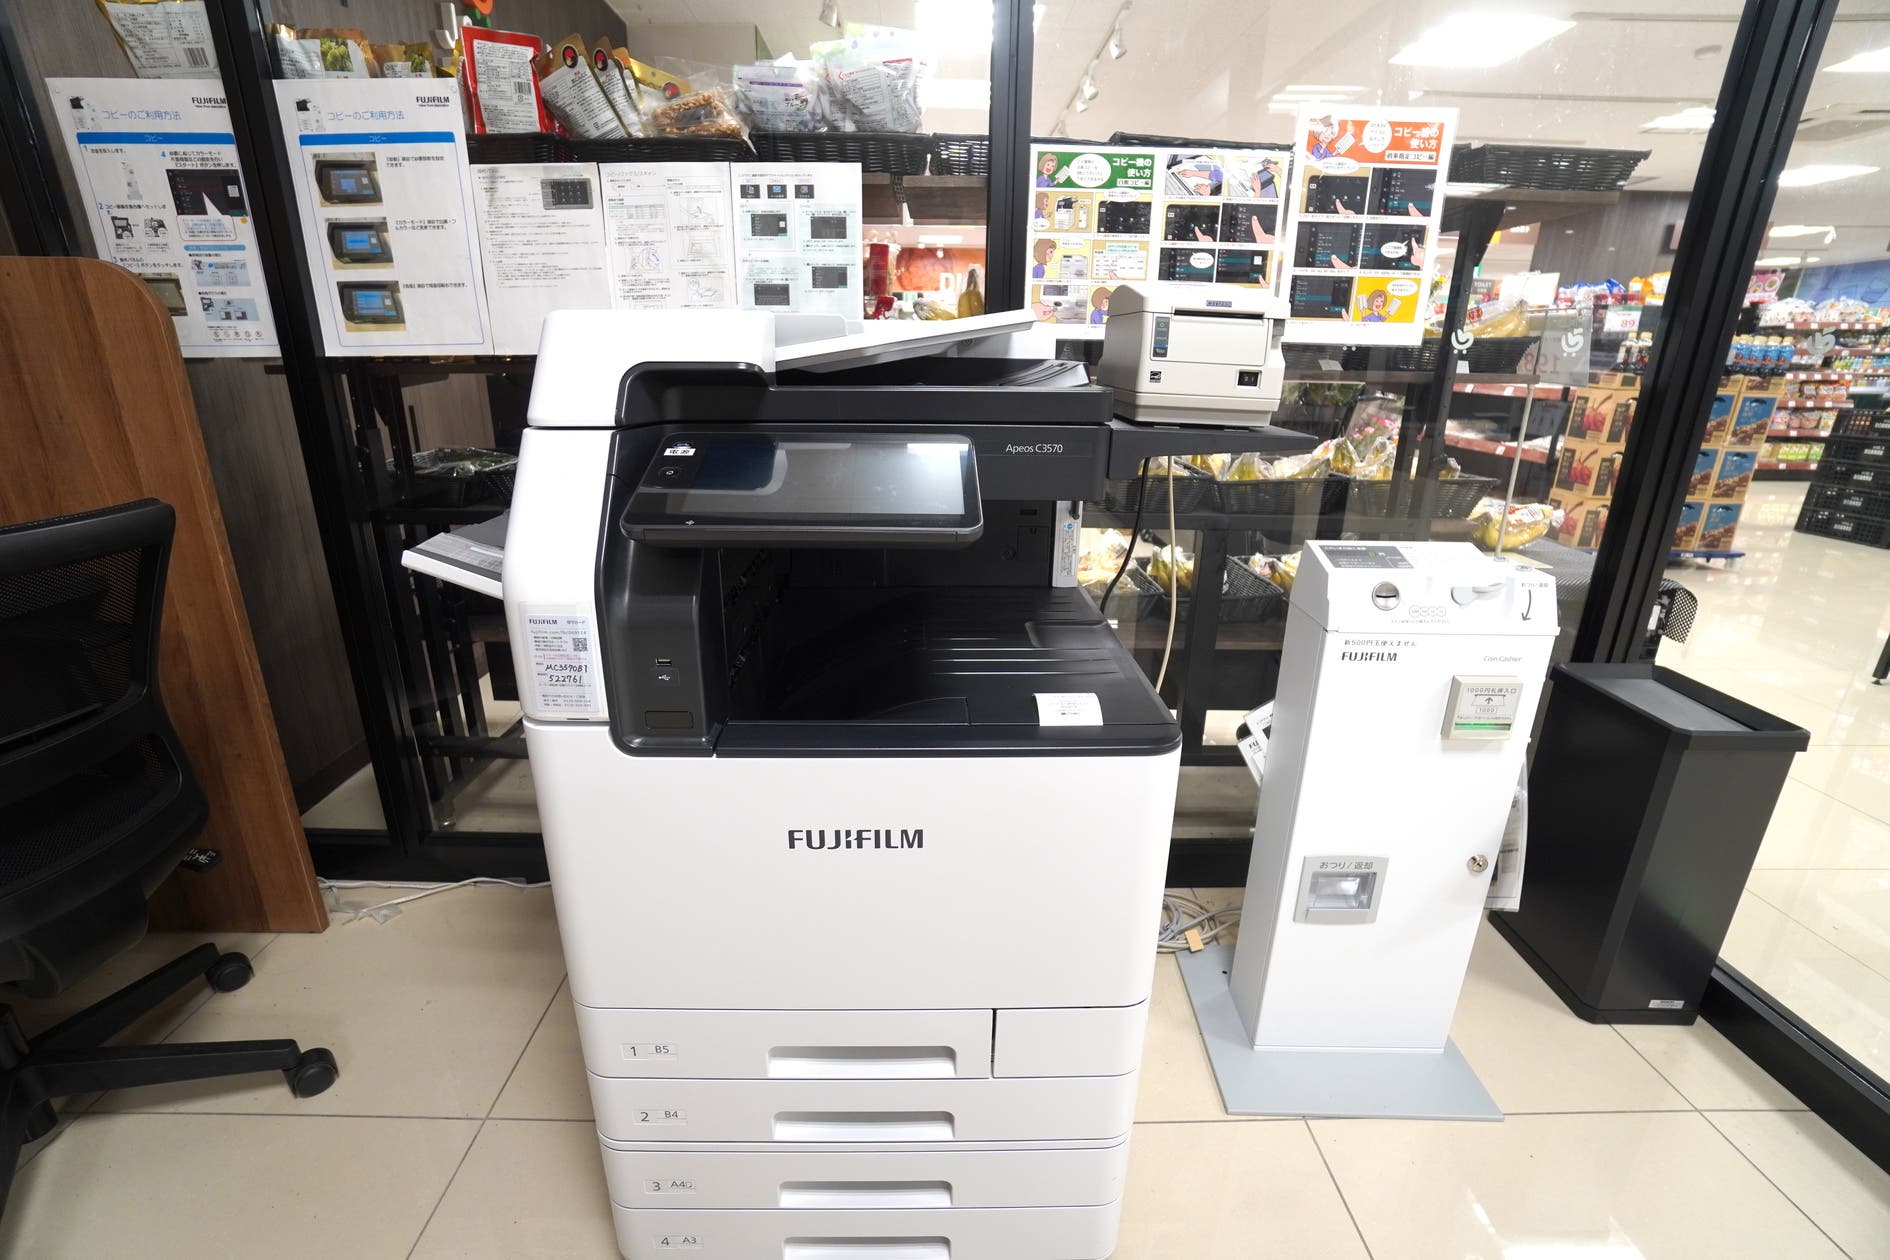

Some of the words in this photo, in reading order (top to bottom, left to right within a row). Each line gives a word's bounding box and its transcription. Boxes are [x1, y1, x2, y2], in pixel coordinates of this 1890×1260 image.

[102, 110, 182, 121] コピーのご利用方法
[327, 110, 405, 120] コピーのご利用方法
[1394, 126, 1440, 138] コピー機の
[144, 134, 163, 142] コピー
[1410, 138, 1438, 150] 使い方
[1112, 158, 1152, 167] コピー機の
[1127, 168, 1151, 178] 使い方
[1620, 319, 1636, 328] 89
[1006, 444, 1034, 454] Apeos
[1035, 444, 1064, 453] C3570
[1342, 652, 1398, 662] FUJIFILM
[549, 674, 582, 684] 522761
[788, 828, 924, 850] FUJIFILM
[630, 1046, 637, 1057] 1
[654, 1045, 670, 1054] B5
[640, 1111, 650, 1122] 2
[664, 1110, 678, 1119] B4
[652, 1182, 661, 1192] 3
[660, 1237, 670, 1247] 4
[682, 1236, 697, 1244] A3
